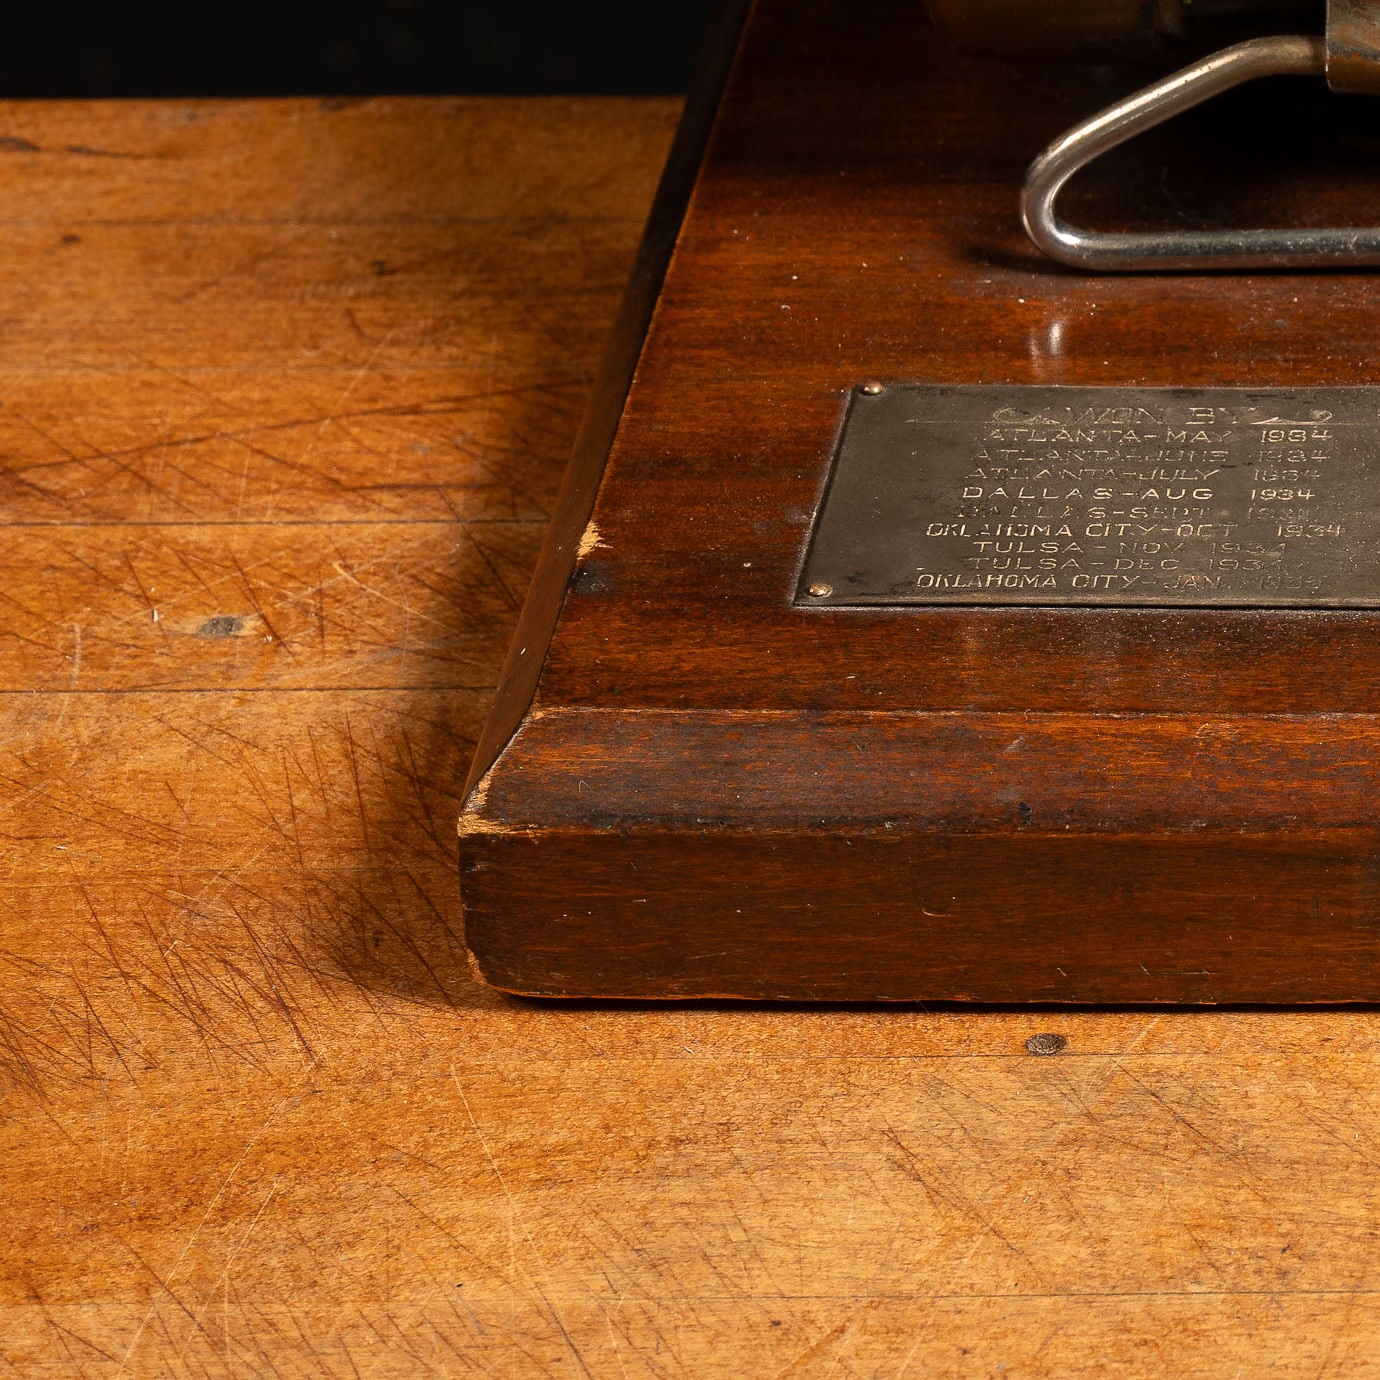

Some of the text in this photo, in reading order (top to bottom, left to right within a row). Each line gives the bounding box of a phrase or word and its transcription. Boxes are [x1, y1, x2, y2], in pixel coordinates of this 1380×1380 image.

[1260, 428, 1333, 444] 1934
[961, 486, 1315, 501] DALLAS-AUG 1934
[926, 522, 1073, 537] OKLAHOMA
[1276, 523, 1343, 538] 1934
[972, 541, 1084, 554] TULSA
[1119, 541, 1185, 555] NOV
[967, 557, 1082, 571] TULSA
[1112, 558, 1181, 572] DEC
[916, 574, 1057, 589] OKLAHOMA
